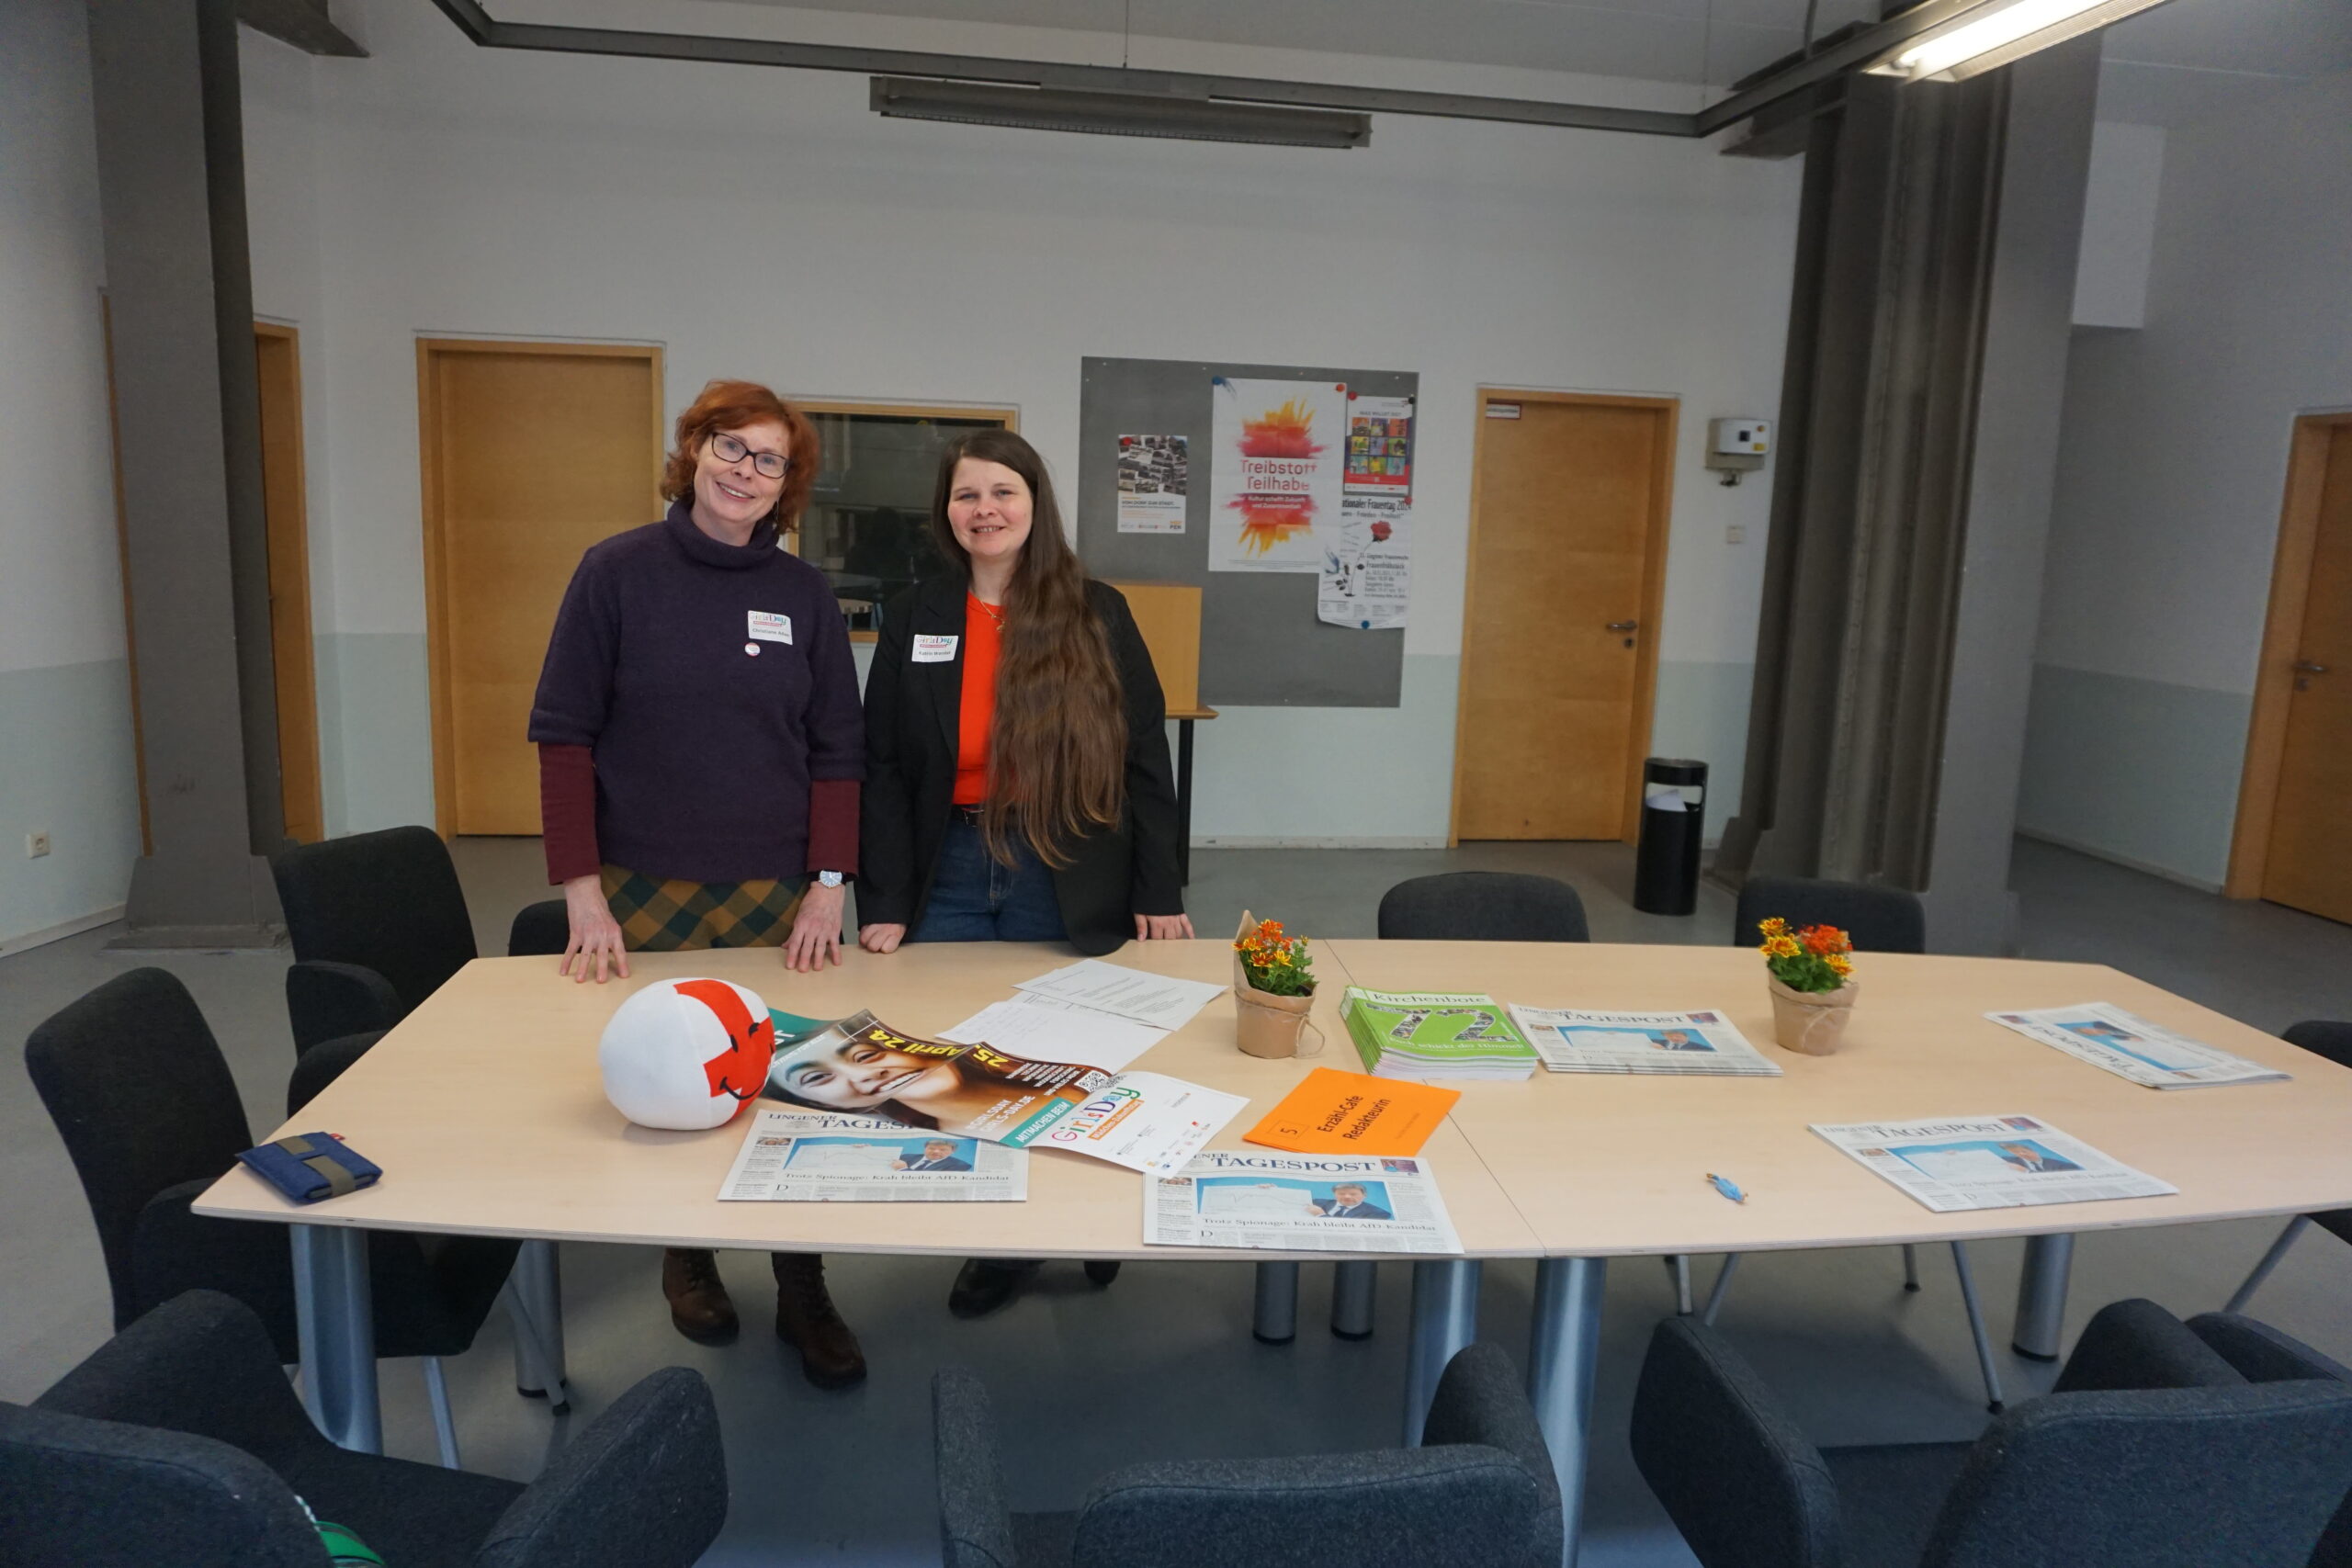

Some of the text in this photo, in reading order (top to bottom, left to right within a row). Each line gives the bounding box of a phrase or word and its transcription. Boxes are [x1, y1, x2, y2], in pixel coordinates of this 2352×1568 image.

[1367, 498, 1396, 512] Frauentag
[1374, 993, 1486, 1003] Kirchenbote
[1365, 1002, 1521, 1043] 72
[1562, 1012, 1684, 1023] TAGESPOST
[868, 1029, 907, 1049] 24
[973, 1043, 1009, 1067] 25.
[979, 1095, 1036, 1132] GIRLS-DAY.DE
[1015, 1100, 1071, 1143] MITMACHEN BEIM
[1317, 1095, 1363, 1132] Erzähl-Cafe
[1342, 1098, 1391, 1140] Redakteurin
[1872, 1122, 2007, 1139] TAGESPOST
[1210, 1157, 1375, 1172] TAGESPOST
